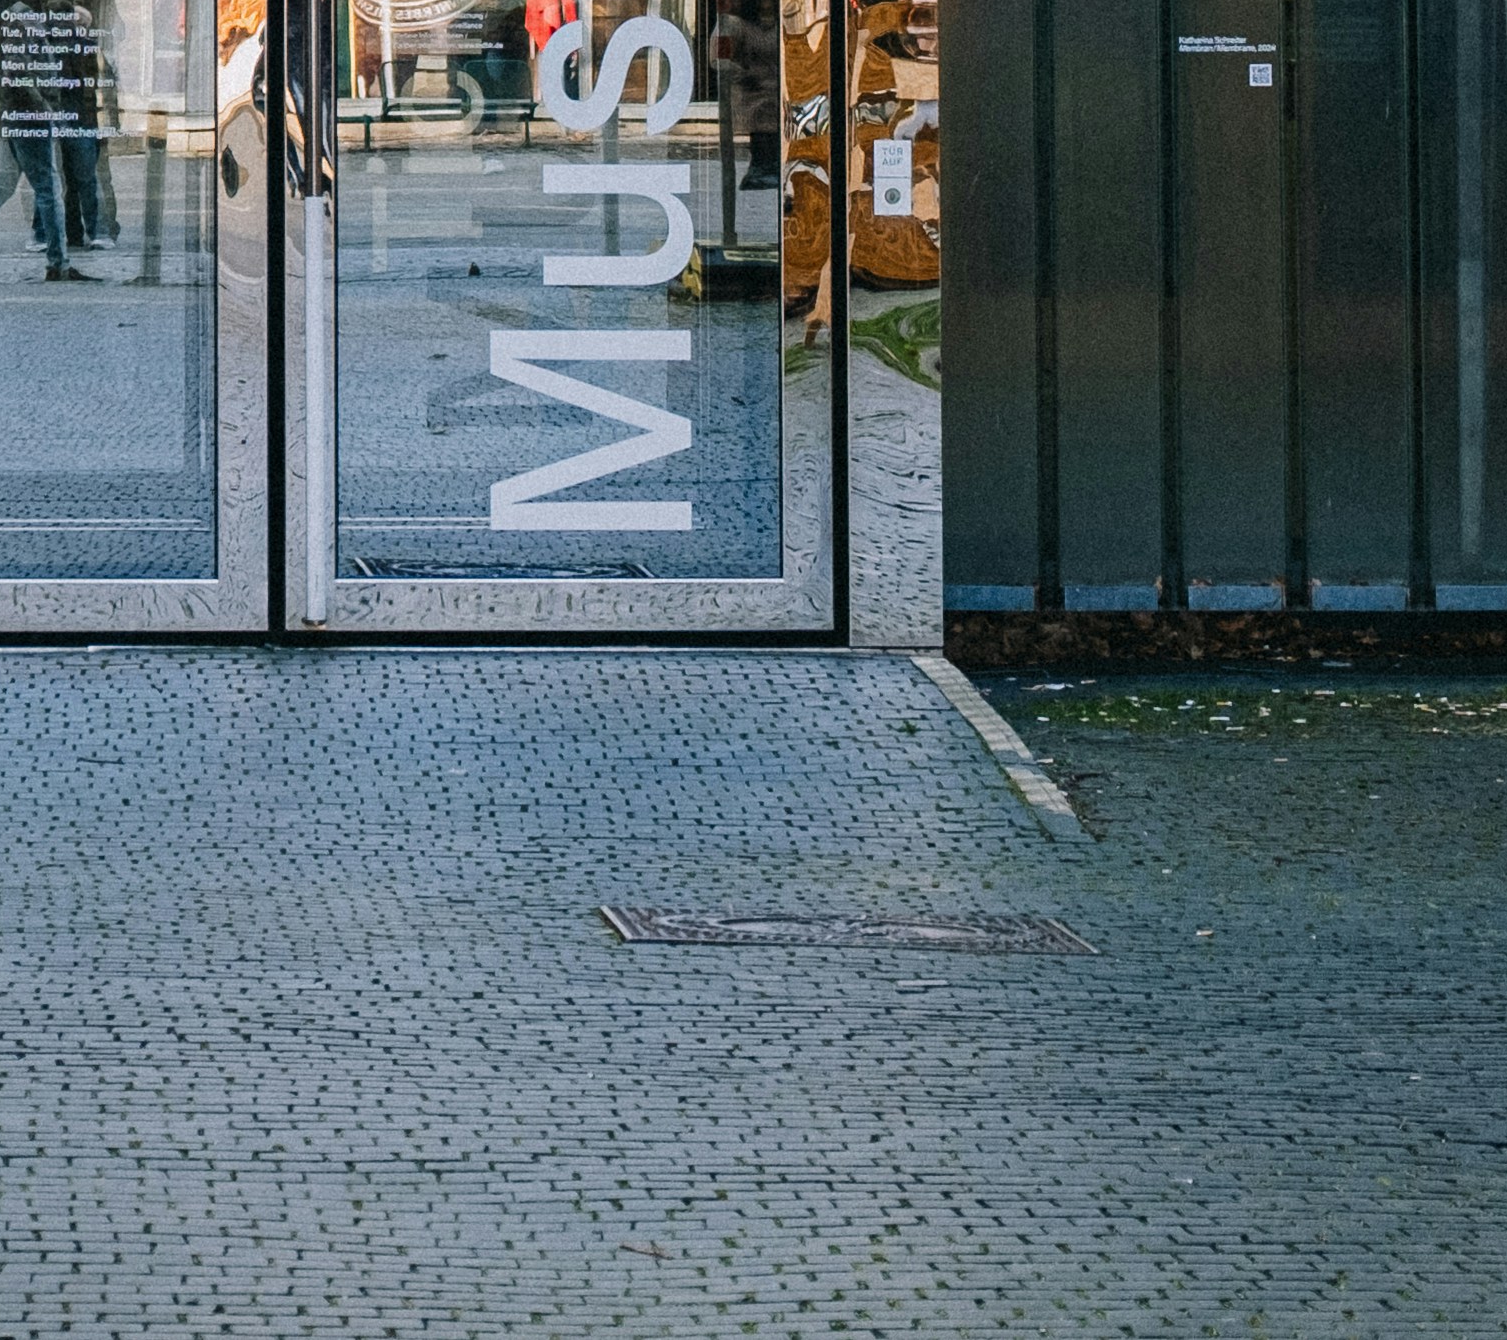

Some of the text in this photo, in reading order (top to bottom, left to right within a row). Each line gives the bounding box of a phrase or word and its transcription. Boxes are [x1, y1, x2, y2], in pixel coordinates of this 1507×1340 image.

[0, 10, 80, 23] Opening hours
[0, 44, 25, 54] Wed
[0, 60, 63, 71] Mon closed
[0, 77, 34, 87] Public
[36, 77, 81, 90] holidays
[0, 110, 79, 121] Administration
[0, 127, 49, 138] Entrance
